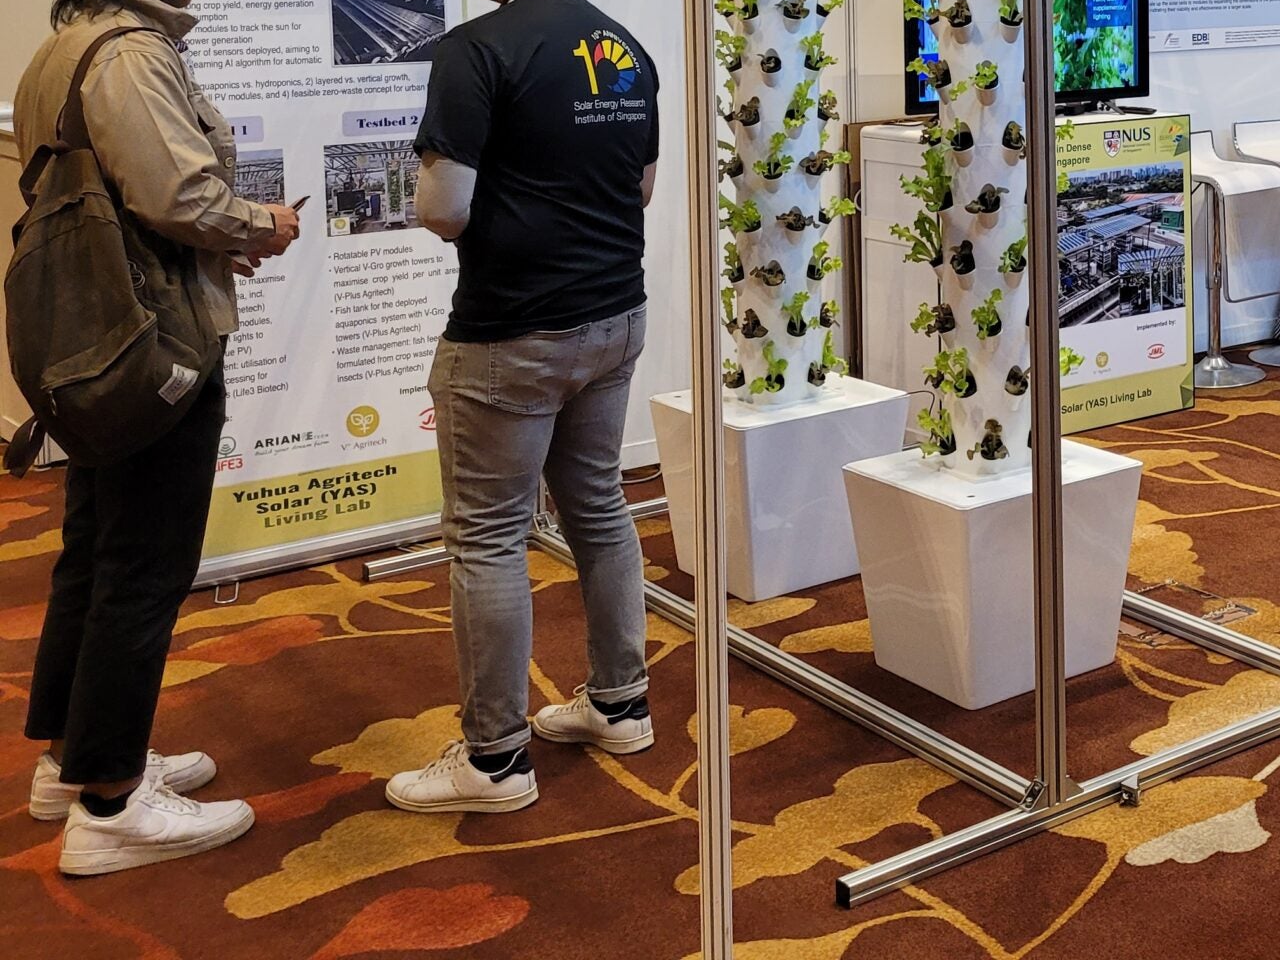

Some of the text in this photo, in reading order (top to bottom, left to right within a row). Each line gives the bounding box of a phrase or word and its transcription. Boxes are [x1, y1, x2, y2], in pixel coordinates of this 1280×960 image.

[204, 0, 314, 11] crop energy generation
[195, 24, 259, 33] modules track
[212, 36, 253, 48] generation
[213, 46, 310, 56] sensors aiming
[236, 56, 322, 69] algorithm automatic
[316, 74, 383, 86] layered vertical
[291, 83, 425, 98] feasible zero-waste concept urban
[574, 98, 646, 111] Solar Energy Research
[356, 116, 418, 129] Testbed 2
[575, 112, 646, 124] Institute of Singapore
[1122, 127, 1151, 143] NUS
[1056, 143, 1092, 153] in Dense
[1056, 156, 1090, 168] ngapore
[333, 245, 413, 260] Rotatable modules
[334, 260, 409, 274] Vertical growth
[249, 274, 285, 285] maximise
[333, 277, 368, 287] maximise
[395, 296, 427, 307] deployed
[335, 313, 406, 329] aquaponics system
[1136, 321, 1167, 331] Implemented
[337, 345, 360, 355] Waste
[241, 358, 277, 368] utilisation
[337, 358, 375, 369] formulated
[257, 382, 289, 394] Biotech)
[1061, 388, 1152, 414] Solar (YAS) Living Lab
[352, 437, 387, 450] Agritech
[233, 464, 397, 503] Yuhua Agritech
[256, 482, 377, 514] Solar (YAS)
[264, 499, 371, 529] Living Lab
